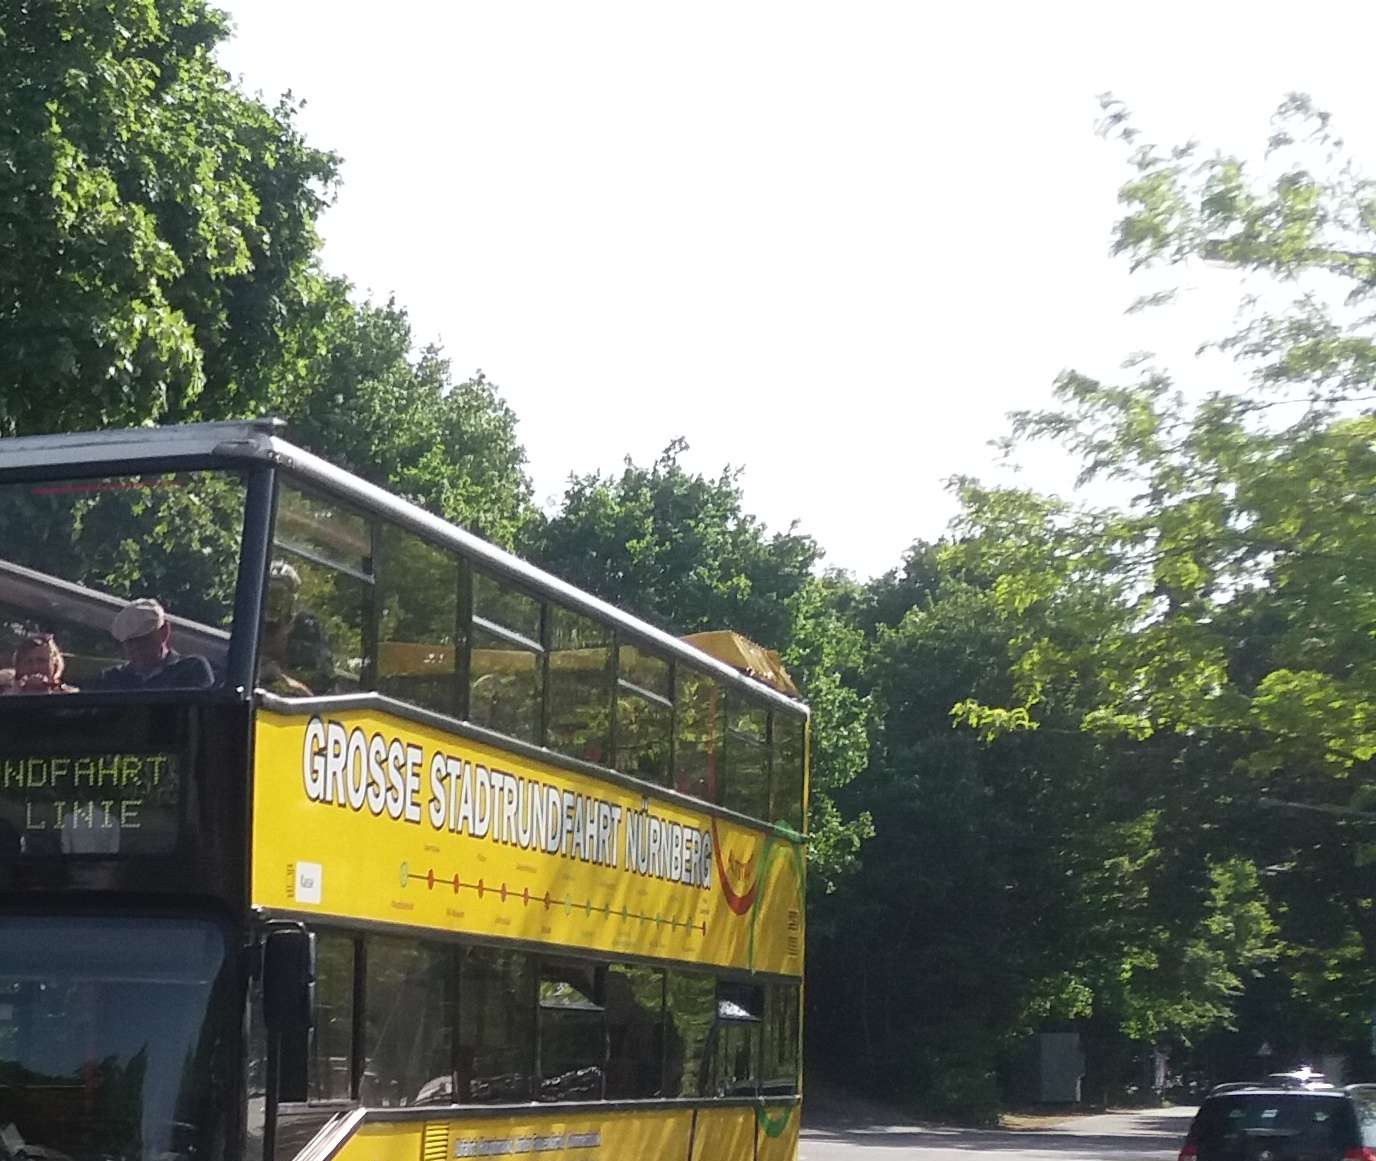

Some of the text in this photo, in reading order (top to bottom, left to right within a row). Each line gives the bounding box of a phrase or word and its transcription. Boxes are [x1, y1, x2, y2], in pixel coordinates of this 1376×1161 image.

[26, 800, 143, 830] LINIE
[303, 714, 713, 890] GROSSE STADTRUNDFAHRT NÜRNBERG
